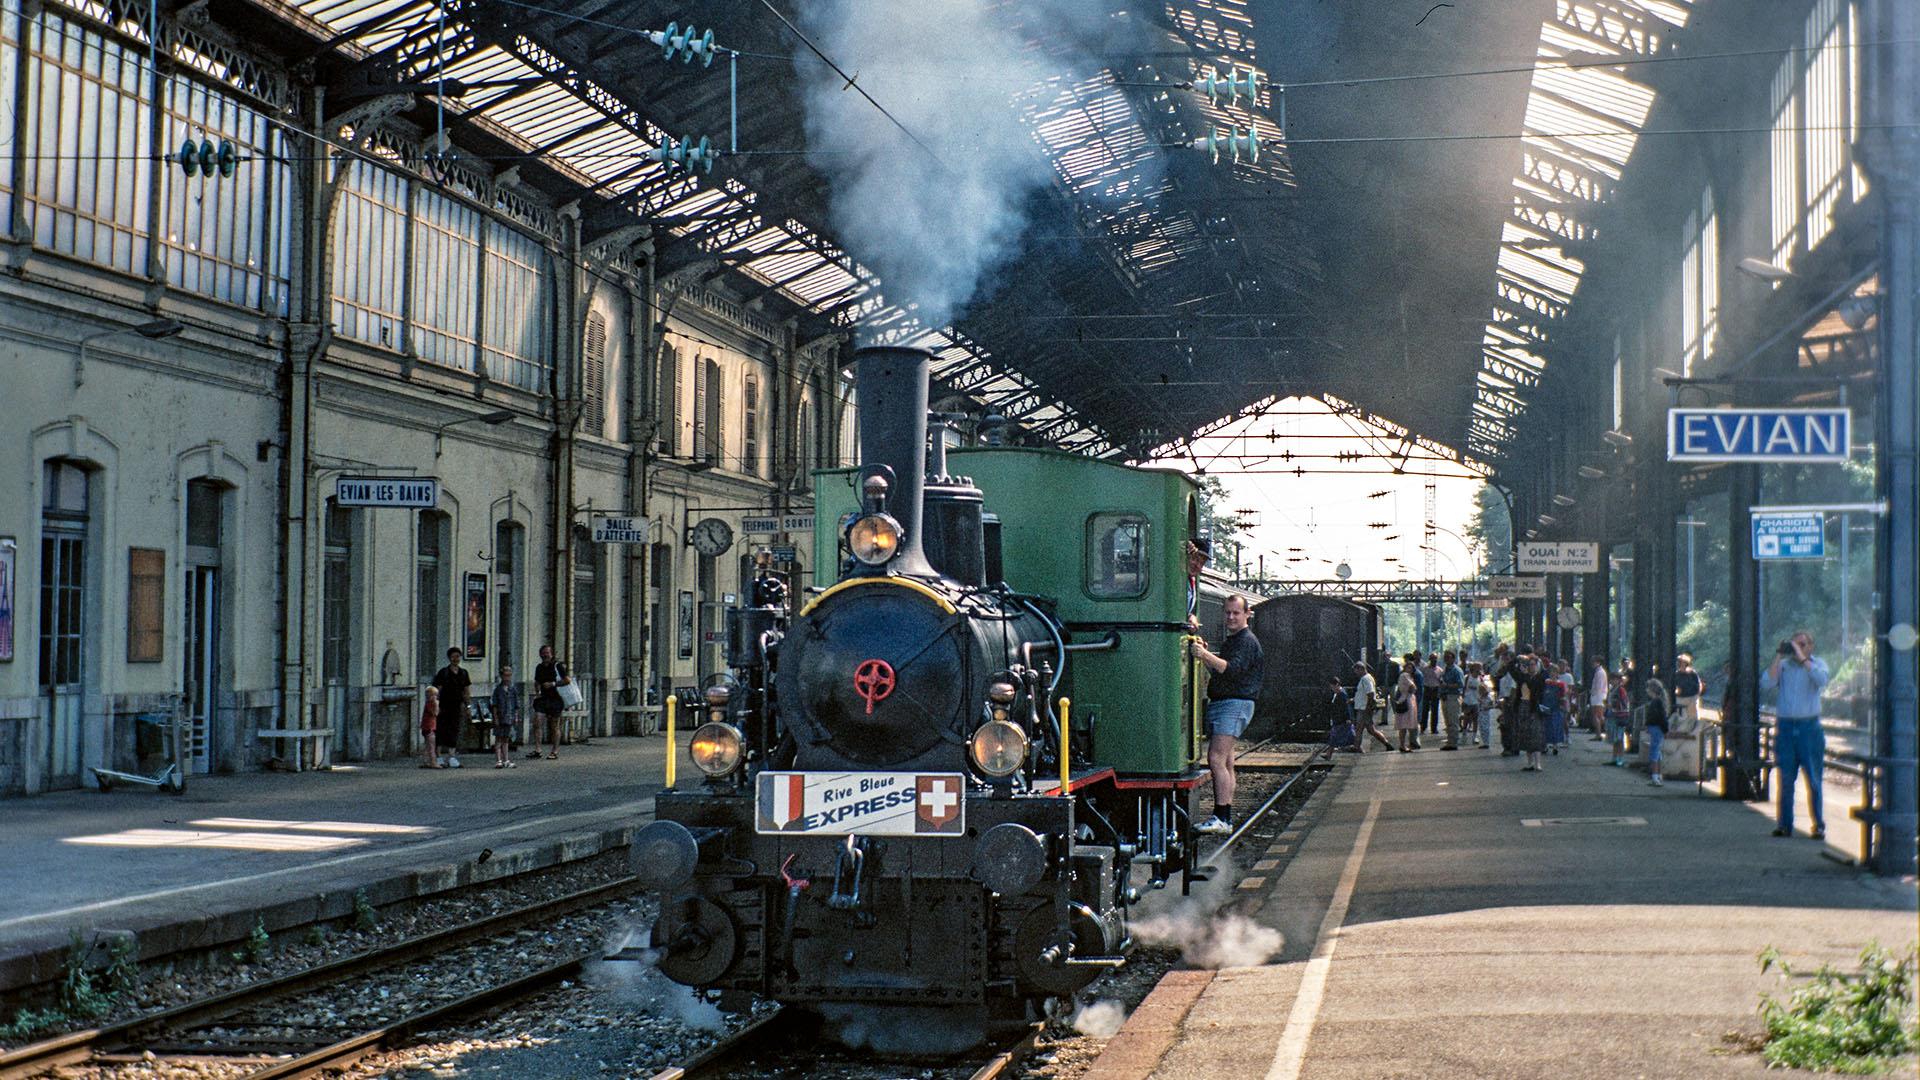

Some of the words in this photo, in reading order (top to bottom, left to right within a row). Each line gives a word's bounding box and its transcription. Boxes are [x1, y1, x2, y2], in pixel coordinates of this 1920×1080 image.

[1683, 414, 1837, 454] EVIAN
[606, 519, 633, 530] SALLE
[1760, 519, 1816, 527] CHARIOTS
[597, 530, 642, 541] D'ATTENTE
[1768, 526, 1820, 534] BAGAGES
[1528, 548, 1559, 557] QUAI
[823, 786, 853, 803] Rive
[859, 776, 895, 793] Bleue
[804, 787, 917, 830] EXPRESS
